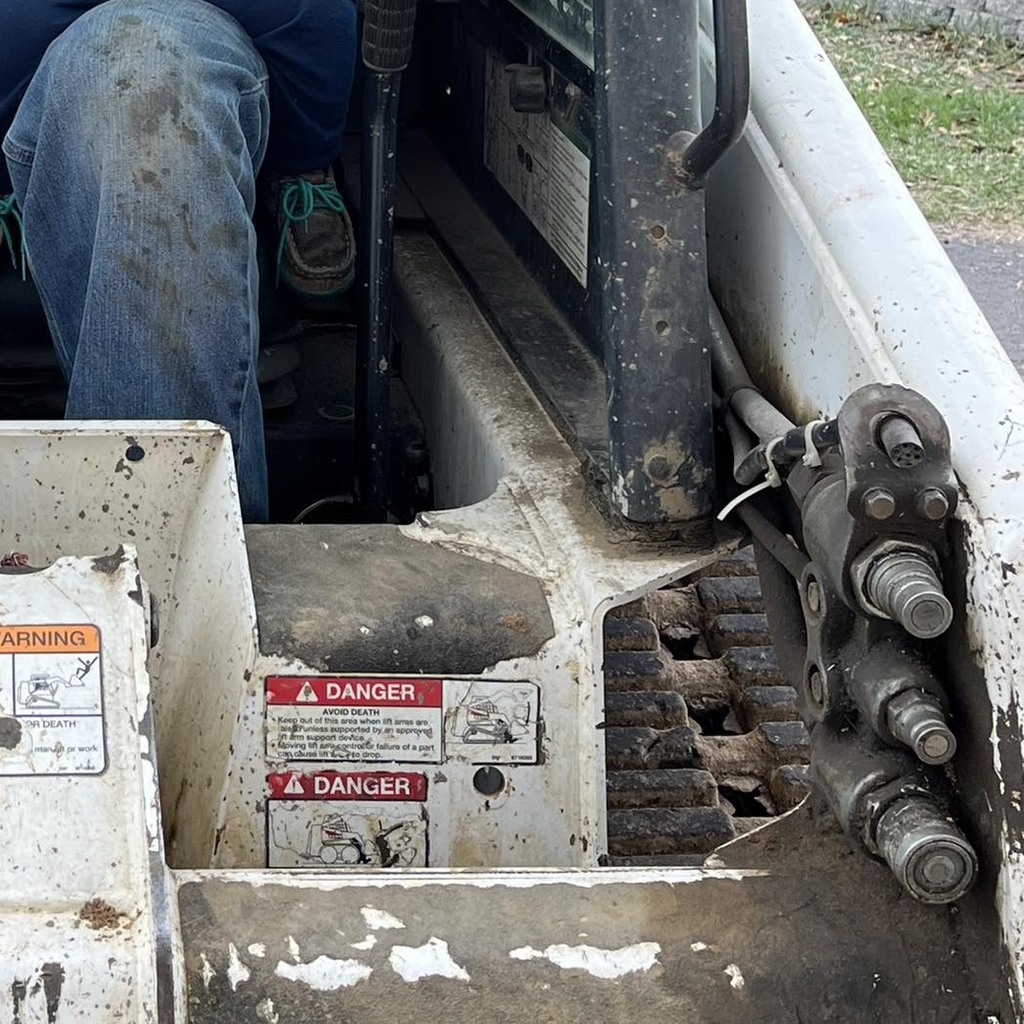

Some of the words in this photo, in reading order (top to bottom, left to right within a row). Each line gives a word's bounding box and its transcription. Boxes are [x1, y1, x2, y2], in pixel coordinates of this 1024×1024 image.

[326, 682, 416, 701] DANGER
[322, 708, 349, 716] AVOID
[351, 708, 380, 716] DEATH
[42, 720, 77, 729] DEATH
[277, 716, 298, 725] Keep
[359, 717, 381, 725] when
[382, 717, 393, 726] lift
[394, 718, 414, 726] arms
[329, 726, 371, 734] supported
[372, 726, 382, 735] by
[396, 727, 433, 736] approved
[306, 734, 336, 742] support
[77, 745, 99, 753] work
[307, 741, 318, 749] lift
[376, 743, 401, 751] failure
[401, 743, 410, 751] of
[418, 744, 435, 752] part
[314, 776, 411, 795] DANGER
